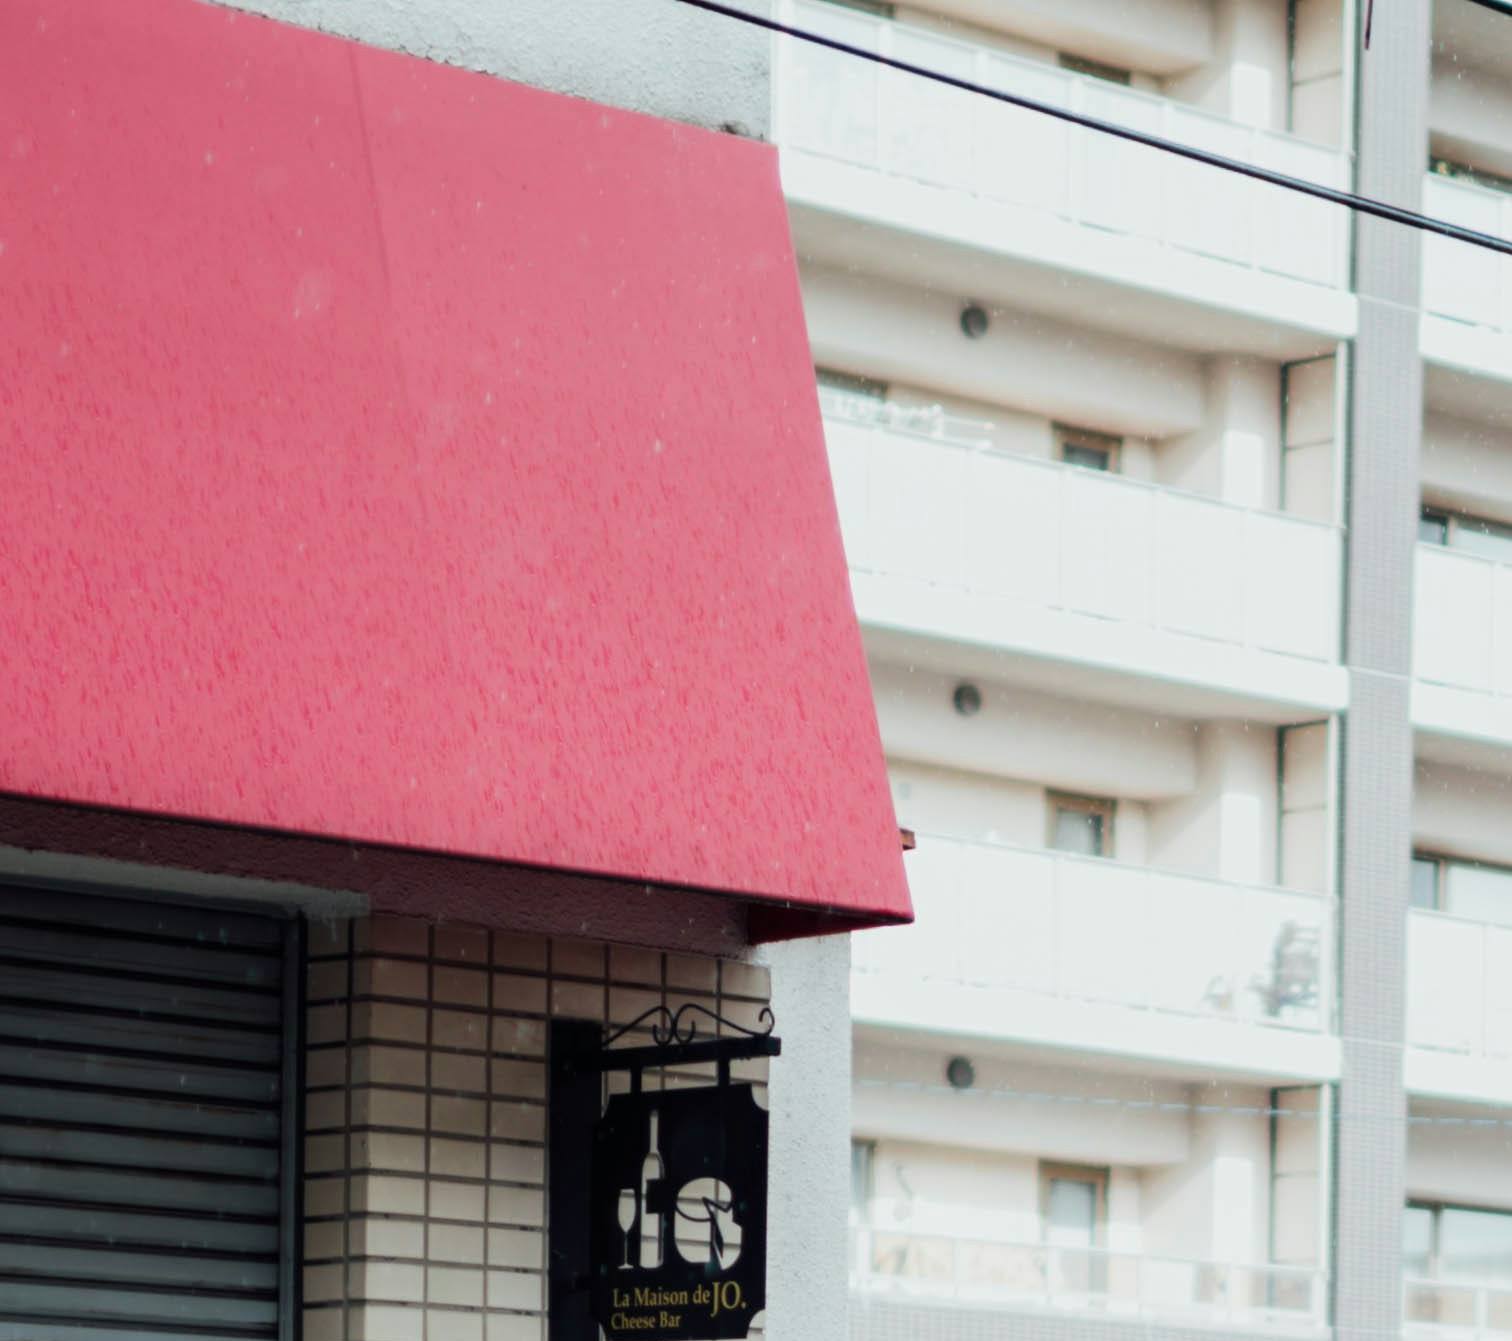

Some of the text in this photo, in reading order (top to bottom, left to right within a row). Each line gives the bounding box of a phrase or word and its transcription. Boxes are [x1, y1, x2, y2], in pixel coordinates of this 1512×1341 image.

[612, 1287, 630, 1309] La
[633, 1285, 688, 1307] Maison
[692, 1284, 710, 1304] de
[611, 1311, 681, 1330] Cheese Bar
